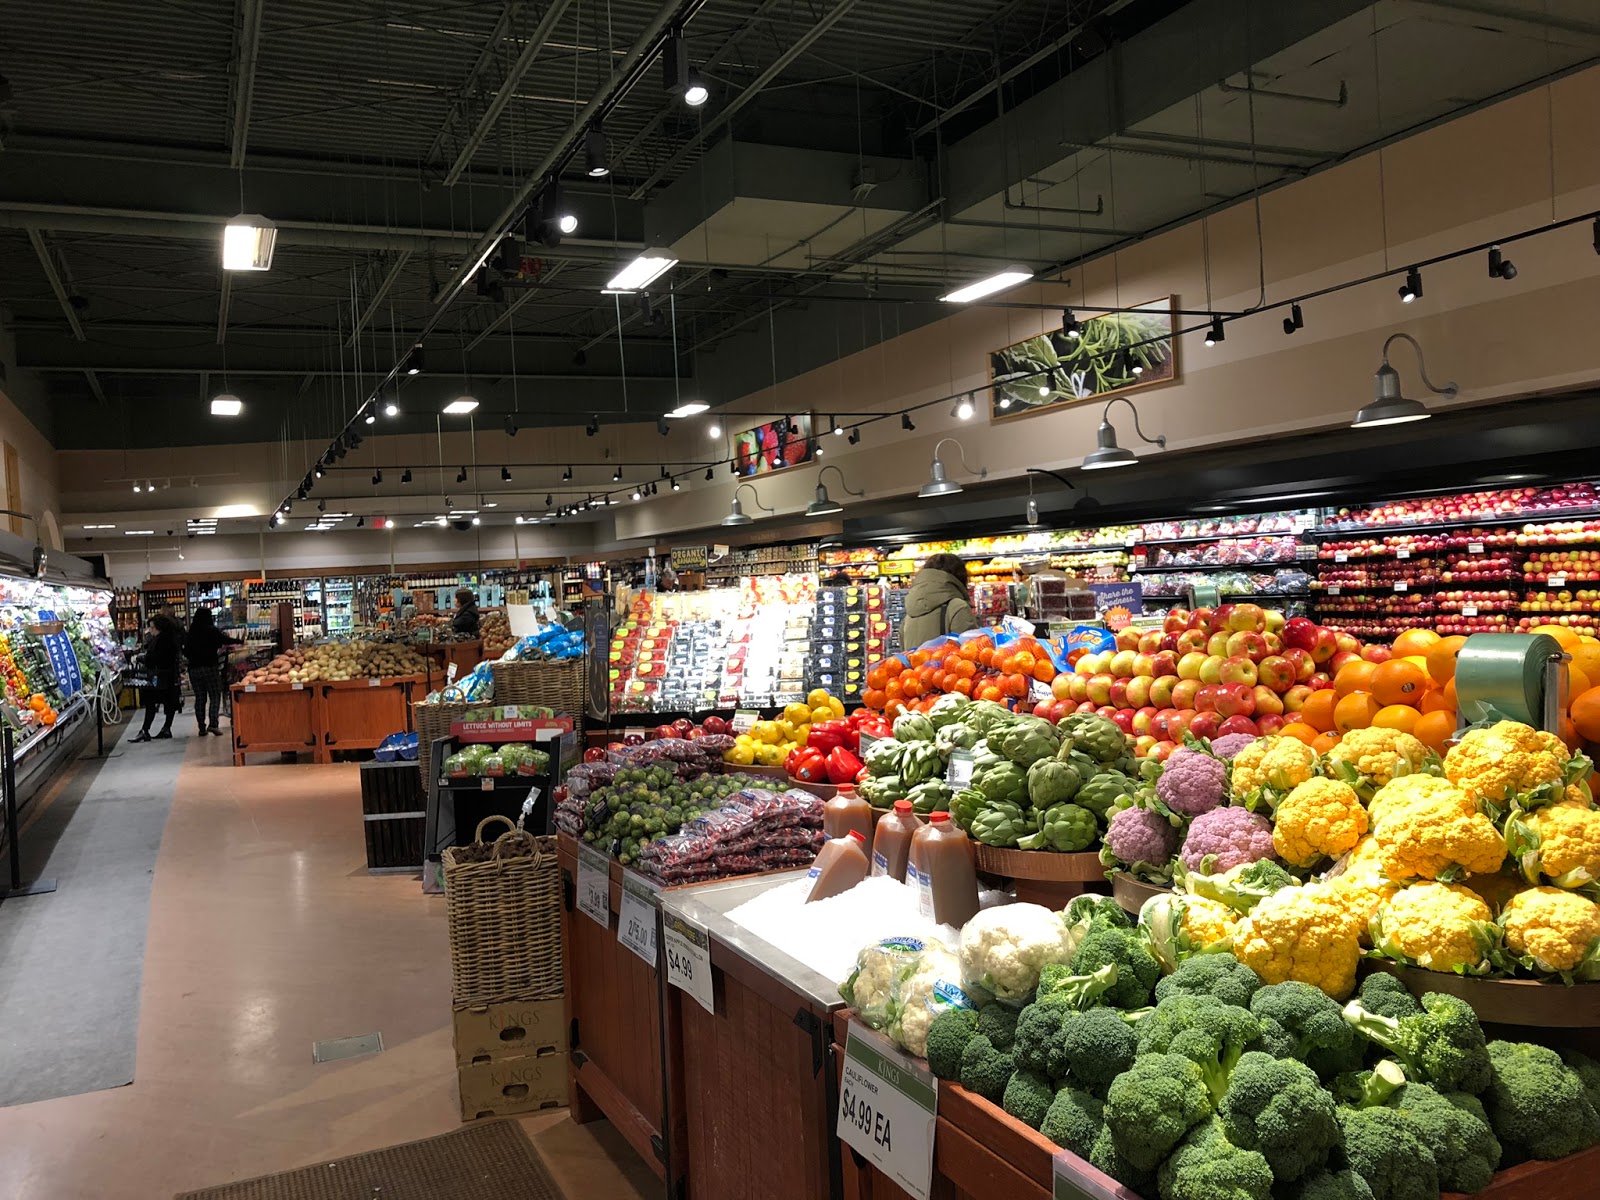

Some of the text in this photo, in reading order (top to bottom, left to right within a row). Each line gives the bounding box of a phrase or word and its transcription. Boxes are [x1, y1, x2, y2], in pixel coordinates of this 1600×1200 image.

[672, 549, 704, 559] ORGANIC
[1097, 587, 1134, 600] Share the
[46, 633, 67, 685] ASTINO
[668, 948, 692, 980] $4.99
[489, 1010, 540, 1030] KINGS
[491, 1066, 542, 1087] KINGS
[844, 1076, 854, 1087] EACH
[845, 1066, 879, 1095] CAULIFLOWER
[877, 1057, 900, 1085] KINGS
[842, 1086, 892, 1152] $4.99 EA
